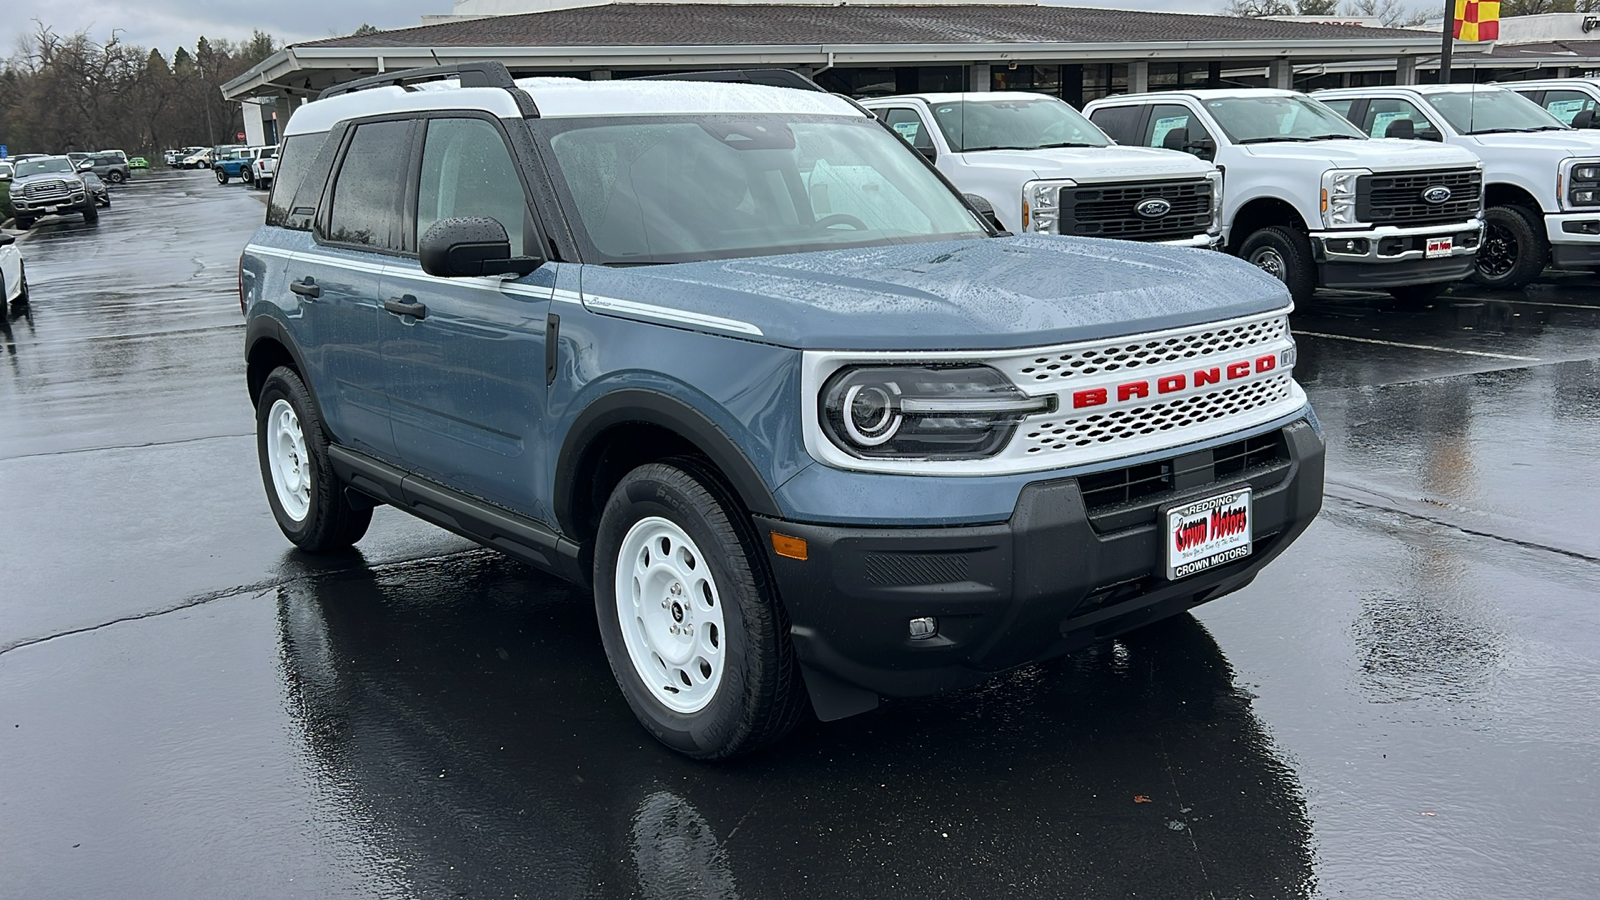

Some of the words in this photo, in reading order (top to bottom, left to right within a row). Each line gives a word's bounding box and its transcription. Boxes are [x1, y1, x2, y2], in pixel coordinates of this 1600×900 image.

[1073, 355, 1275, 409] BRONCO
[1189, 495, 1233, 515] REDDING
[1175, 517, 1208, 552] Crown
[1210, 505, 1247, 541] Motors
[1176, 558, 1209, 577] CROWN
[1211, 546, 1248, 565] MOTORS
